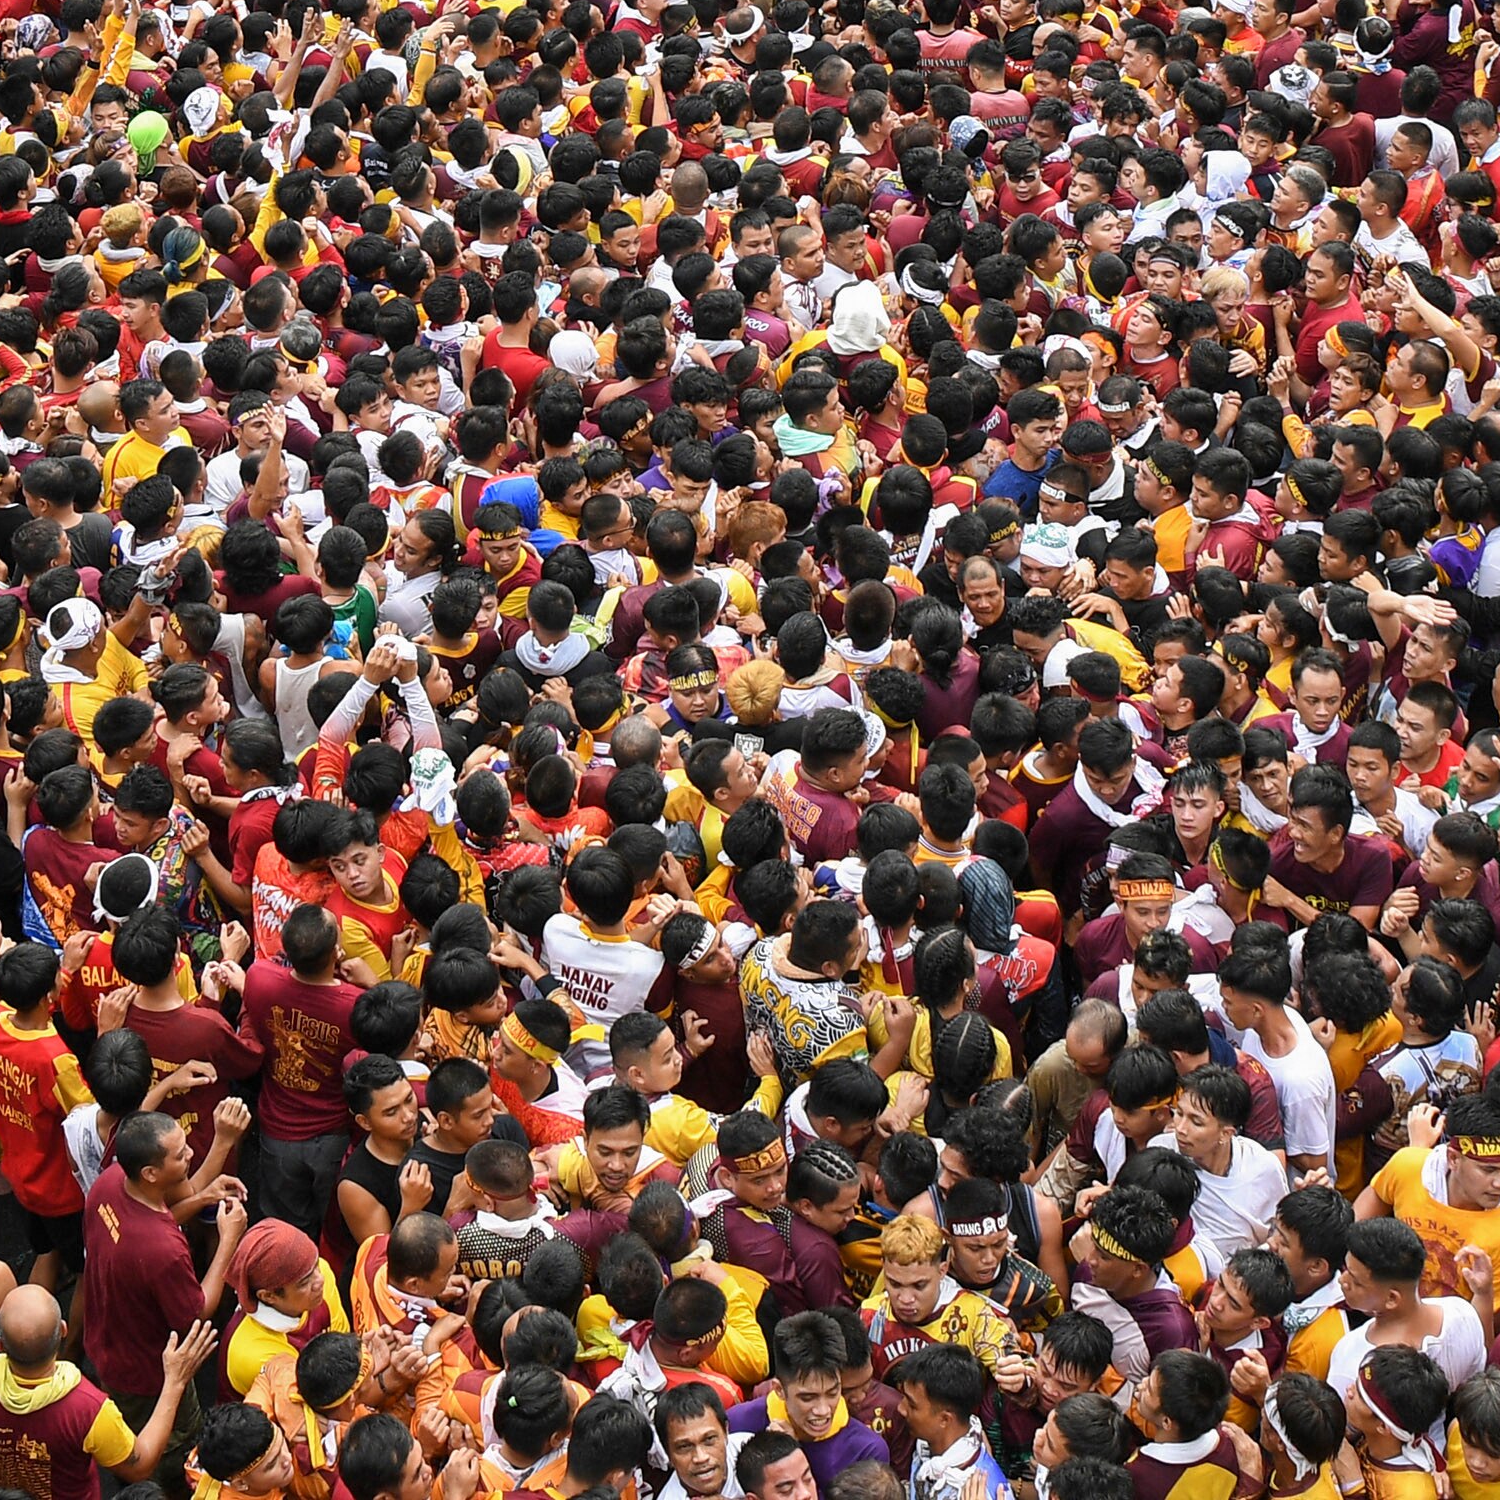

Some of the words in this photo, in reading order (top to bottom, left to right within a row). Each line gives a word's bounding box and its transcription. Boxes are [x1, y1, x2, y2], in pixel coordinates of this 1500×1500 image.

[560, 964, 615, 994] NANAY
[284, 1009, 340, 1045] JESUS
[952, 1222, 981, 1237] BATANG
